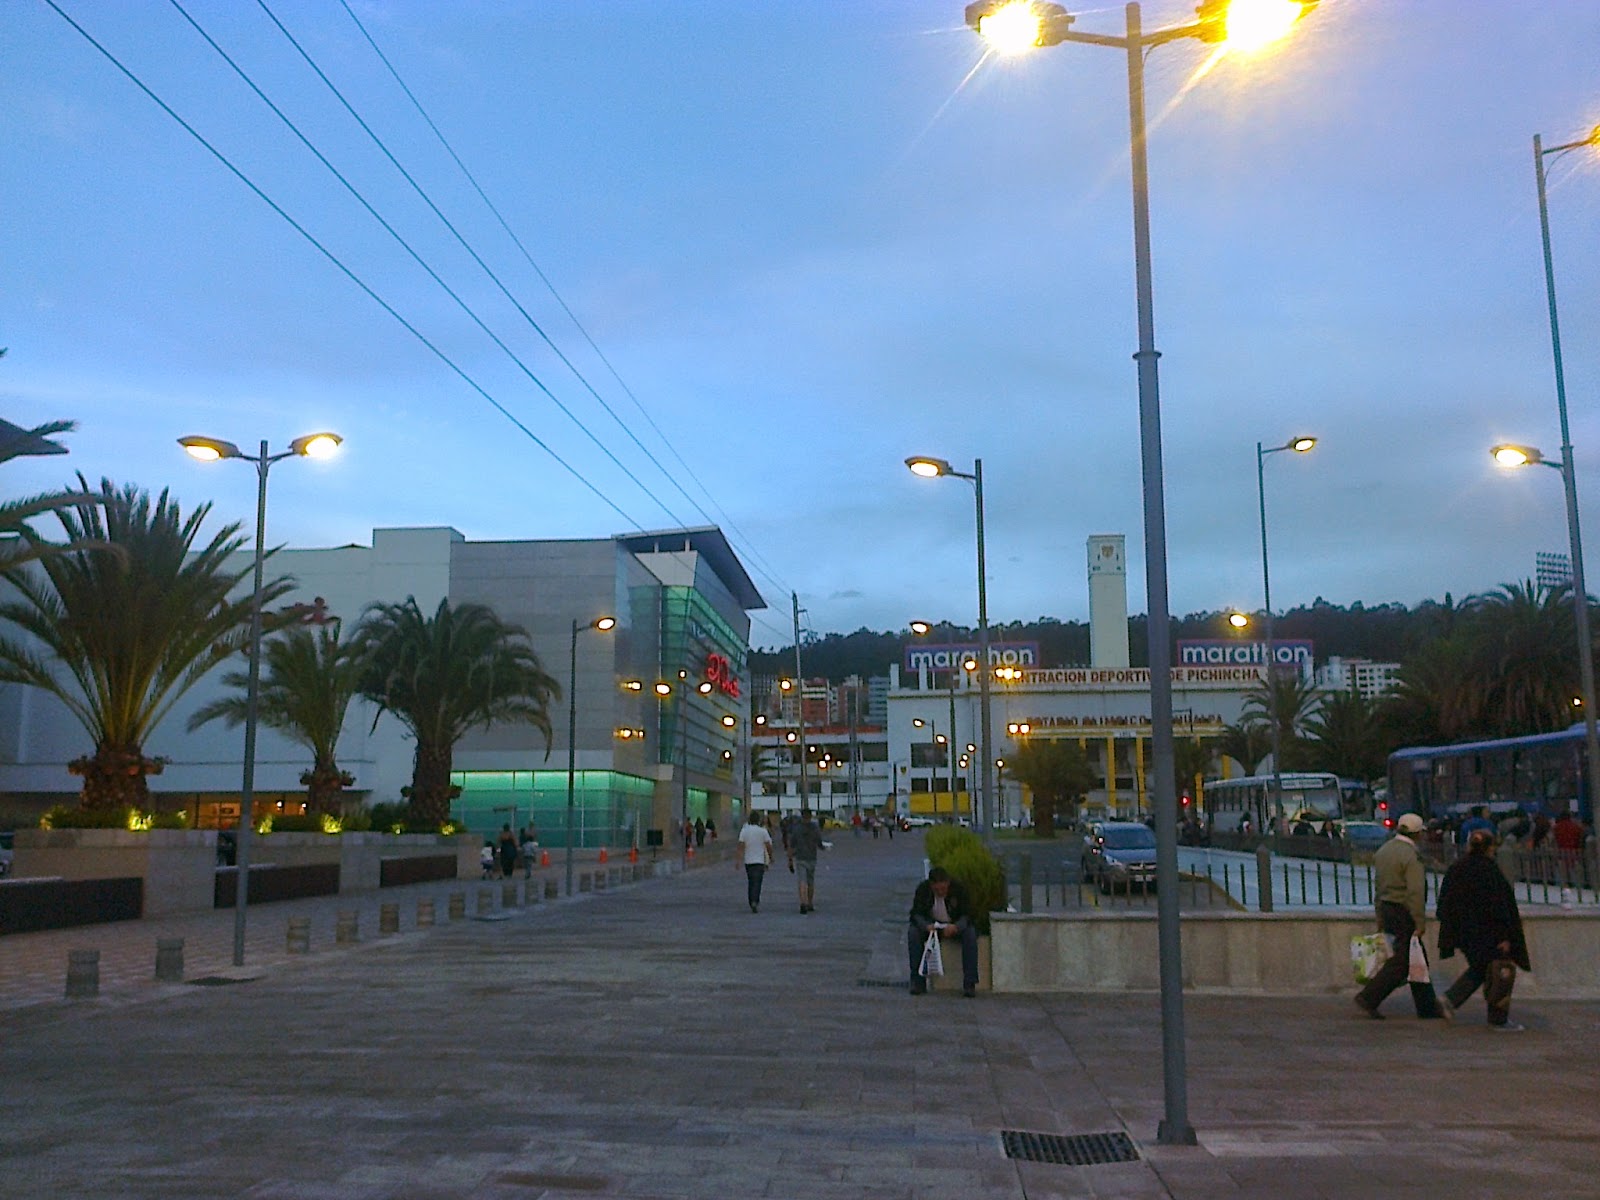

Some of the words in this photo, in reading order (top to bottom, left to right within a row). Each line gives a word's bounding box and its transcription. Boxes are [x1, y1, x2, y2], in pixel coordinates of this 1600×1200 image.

[910, 646, 1034, 668] marahon
[1182, 642, 1309, 664] marathon
[976, 670, 1084, 684] CONNTRACION
[1091, 670, 1150, 683] DEPORTIV
[1171, 669, 1183, 681] DE
[1187, 668, 1260, 682] PICHINCHA
